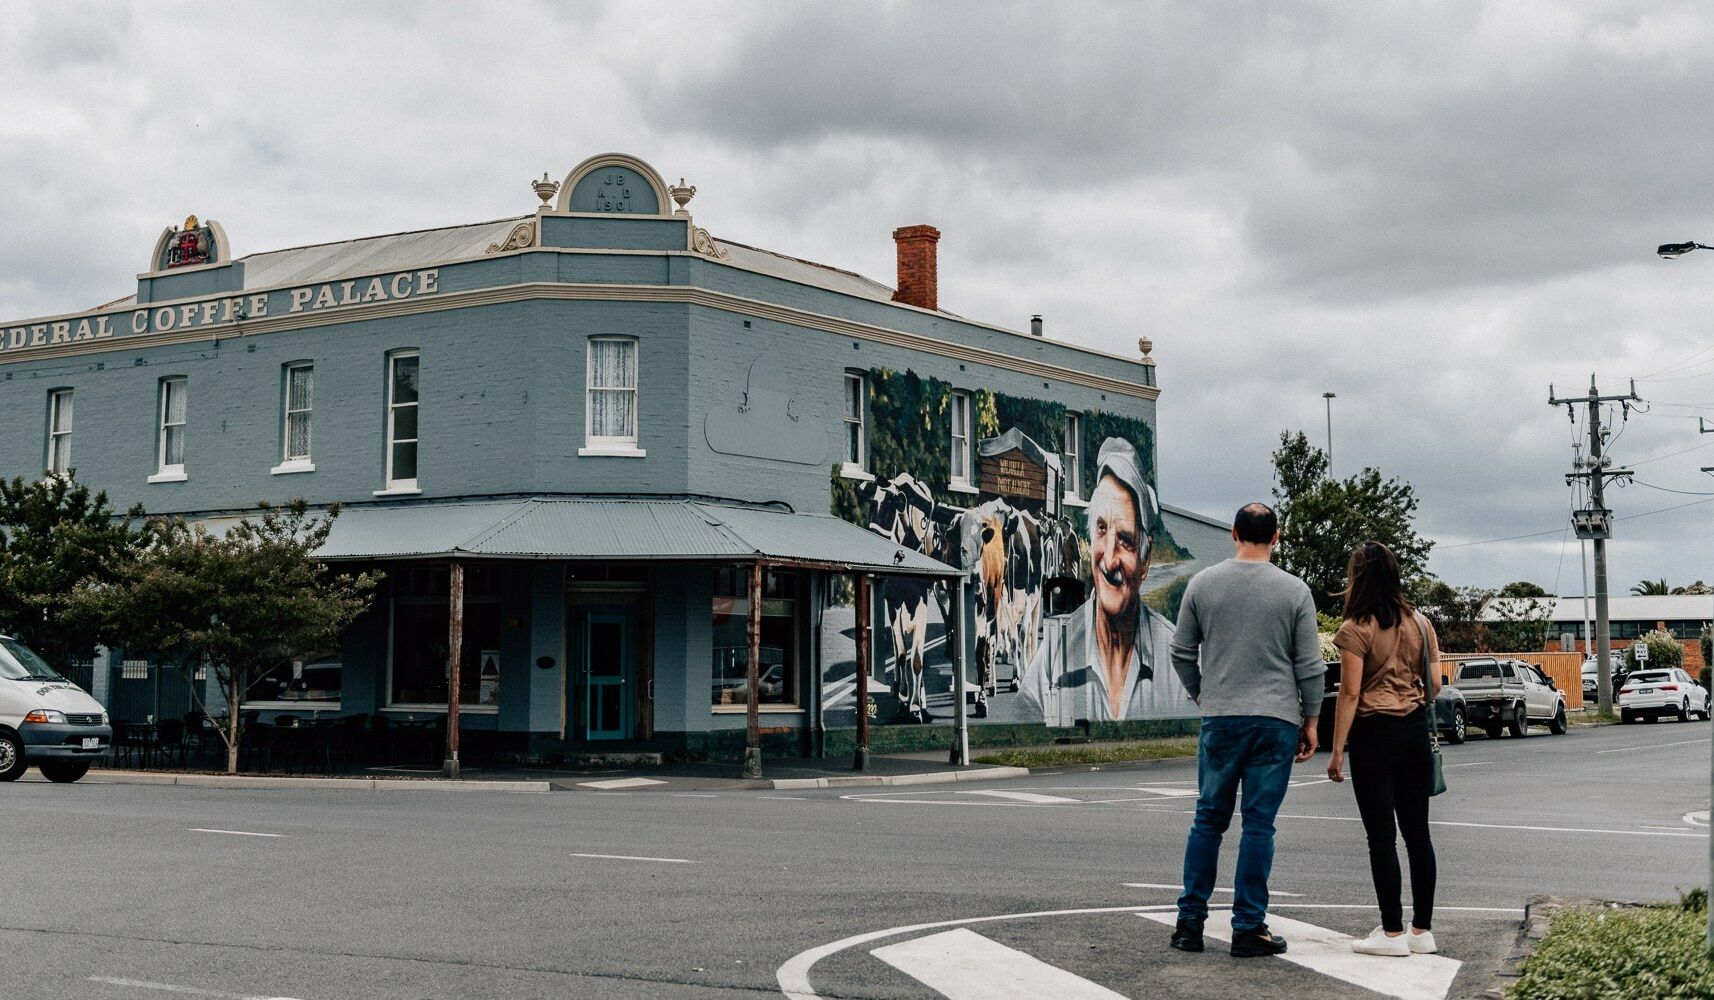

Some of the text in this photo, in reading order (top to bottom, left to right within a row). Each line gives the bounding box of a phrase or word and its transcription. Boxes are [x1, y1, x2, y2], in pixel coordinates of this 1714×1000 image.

[596, 200, 632, 212] 1901
[0, 268, 439, 349] DERAL COFFEE PALACE
